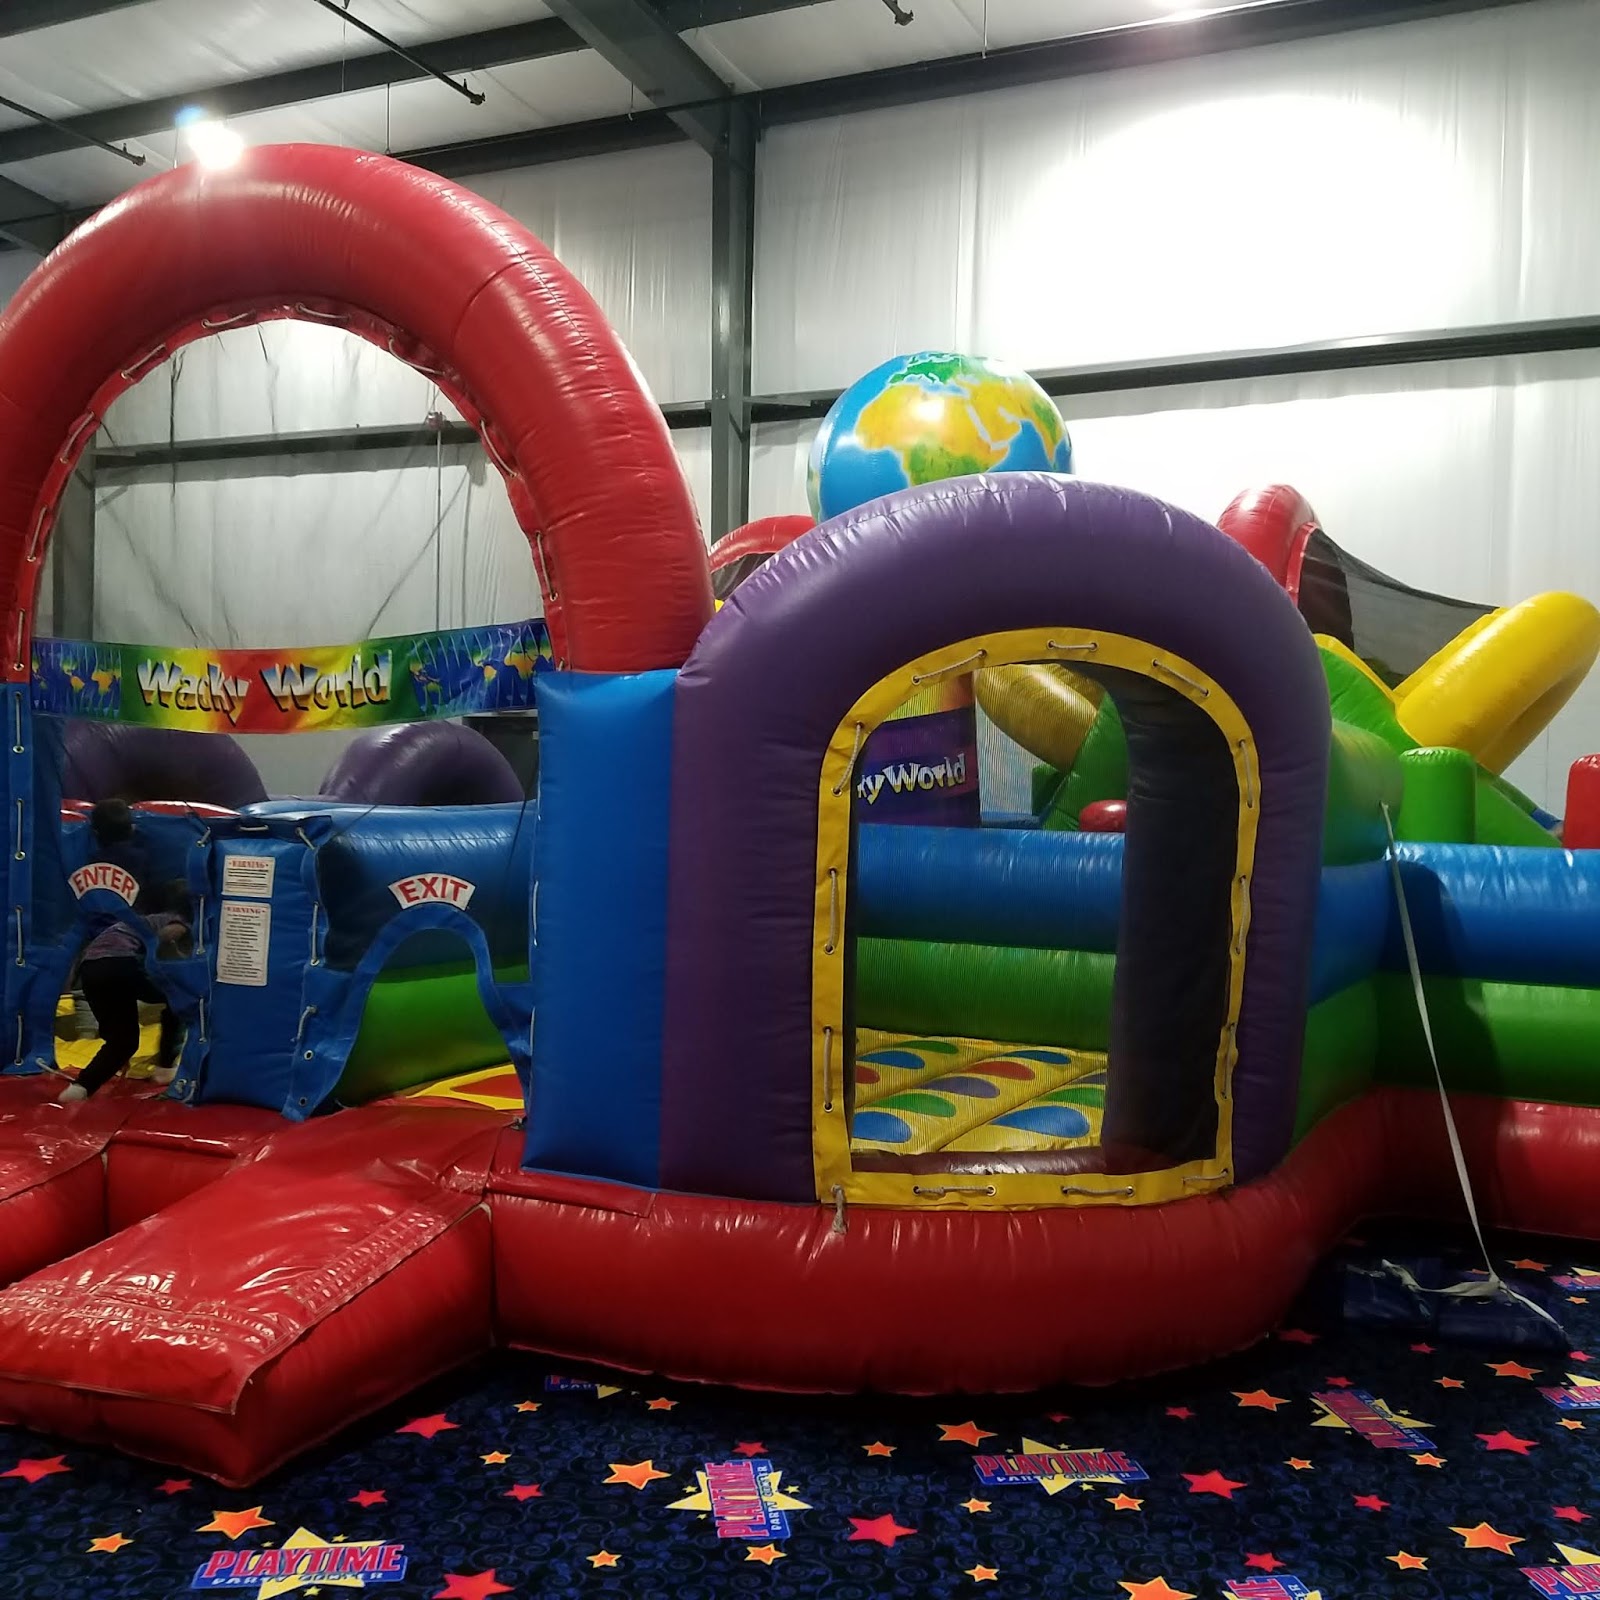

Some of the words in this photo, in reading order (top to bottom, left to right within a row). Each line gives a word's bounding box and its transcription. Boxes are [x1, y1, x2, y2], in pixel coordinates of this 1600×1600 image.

[137, 657, 250, 727] Wacky
[260, 649, 392, 712] World
[882, 753, 967, 795] World
[73, 865, 135, 899] ENTER
[397, 876, 469, 903] EXIT
[972, 1451, 1139, 1477] PLAYTIME
[704, 1461, 770, 1538] PLAYTIME
[200, 1544, 405, 1578] PLAYTIME
